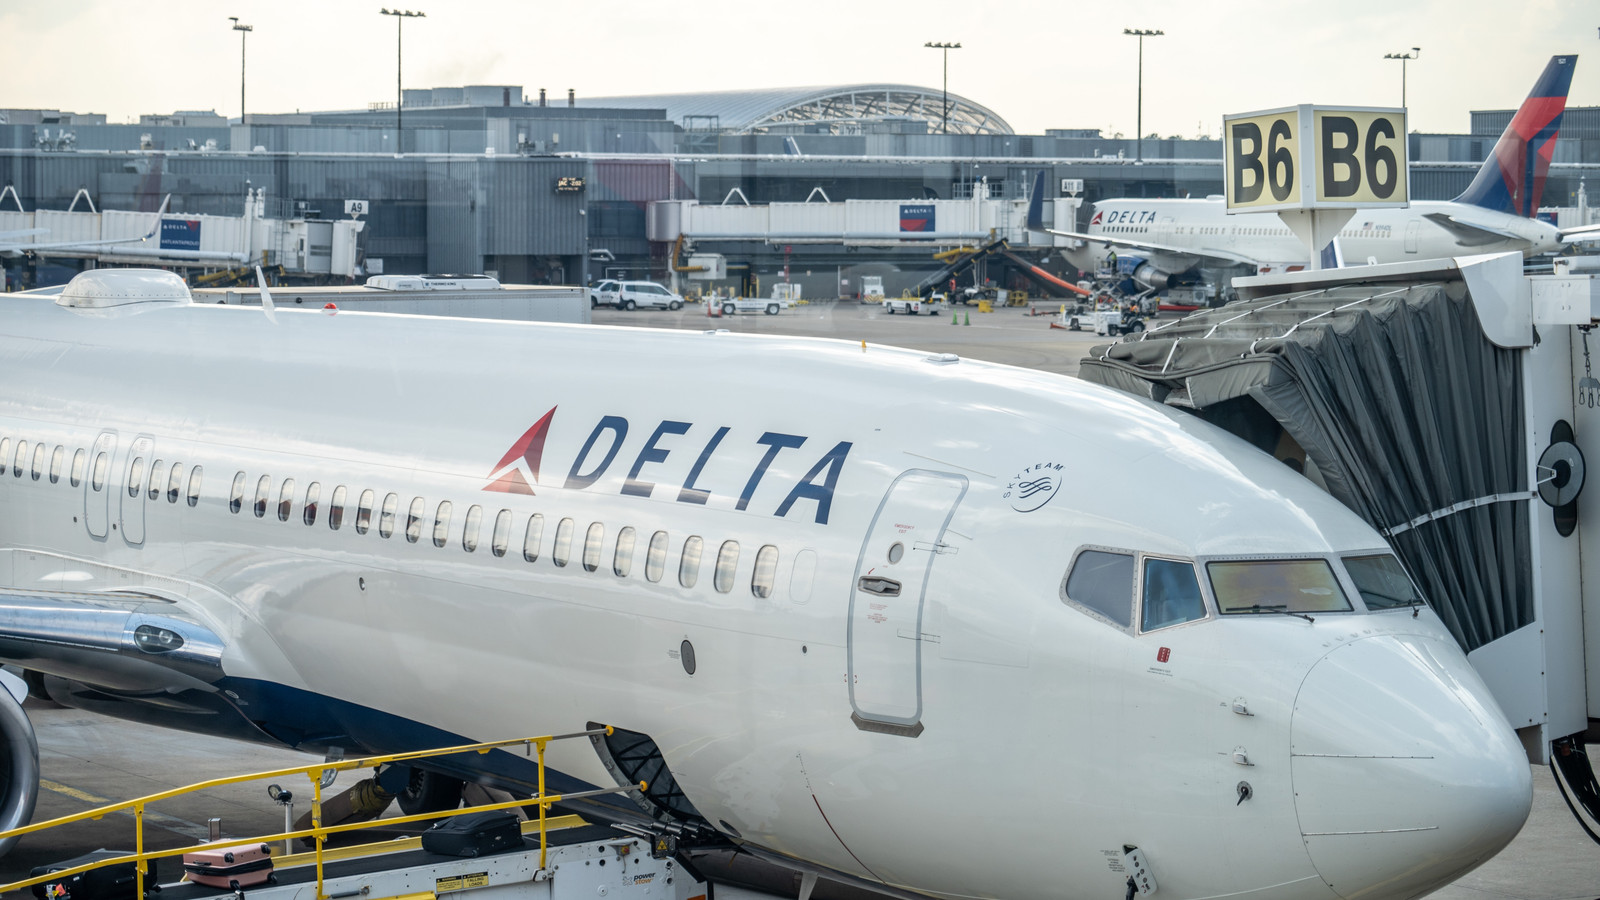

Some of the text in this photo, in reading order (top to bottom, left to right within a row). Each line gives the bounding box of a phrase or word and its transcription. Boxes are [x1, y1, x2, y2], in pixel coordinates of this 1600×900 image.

[1232, 119, 1294, 204] B6
[1322, 116, 1398, 199] B6
[351, 202, 362, 213] A9
[1107, 210, 1157, 224] DELTA
[563, 415, 854, 526] DELTA
[1003, 462, 1064, 499] SKYTEAM
[633, 872, 656, 882] power
